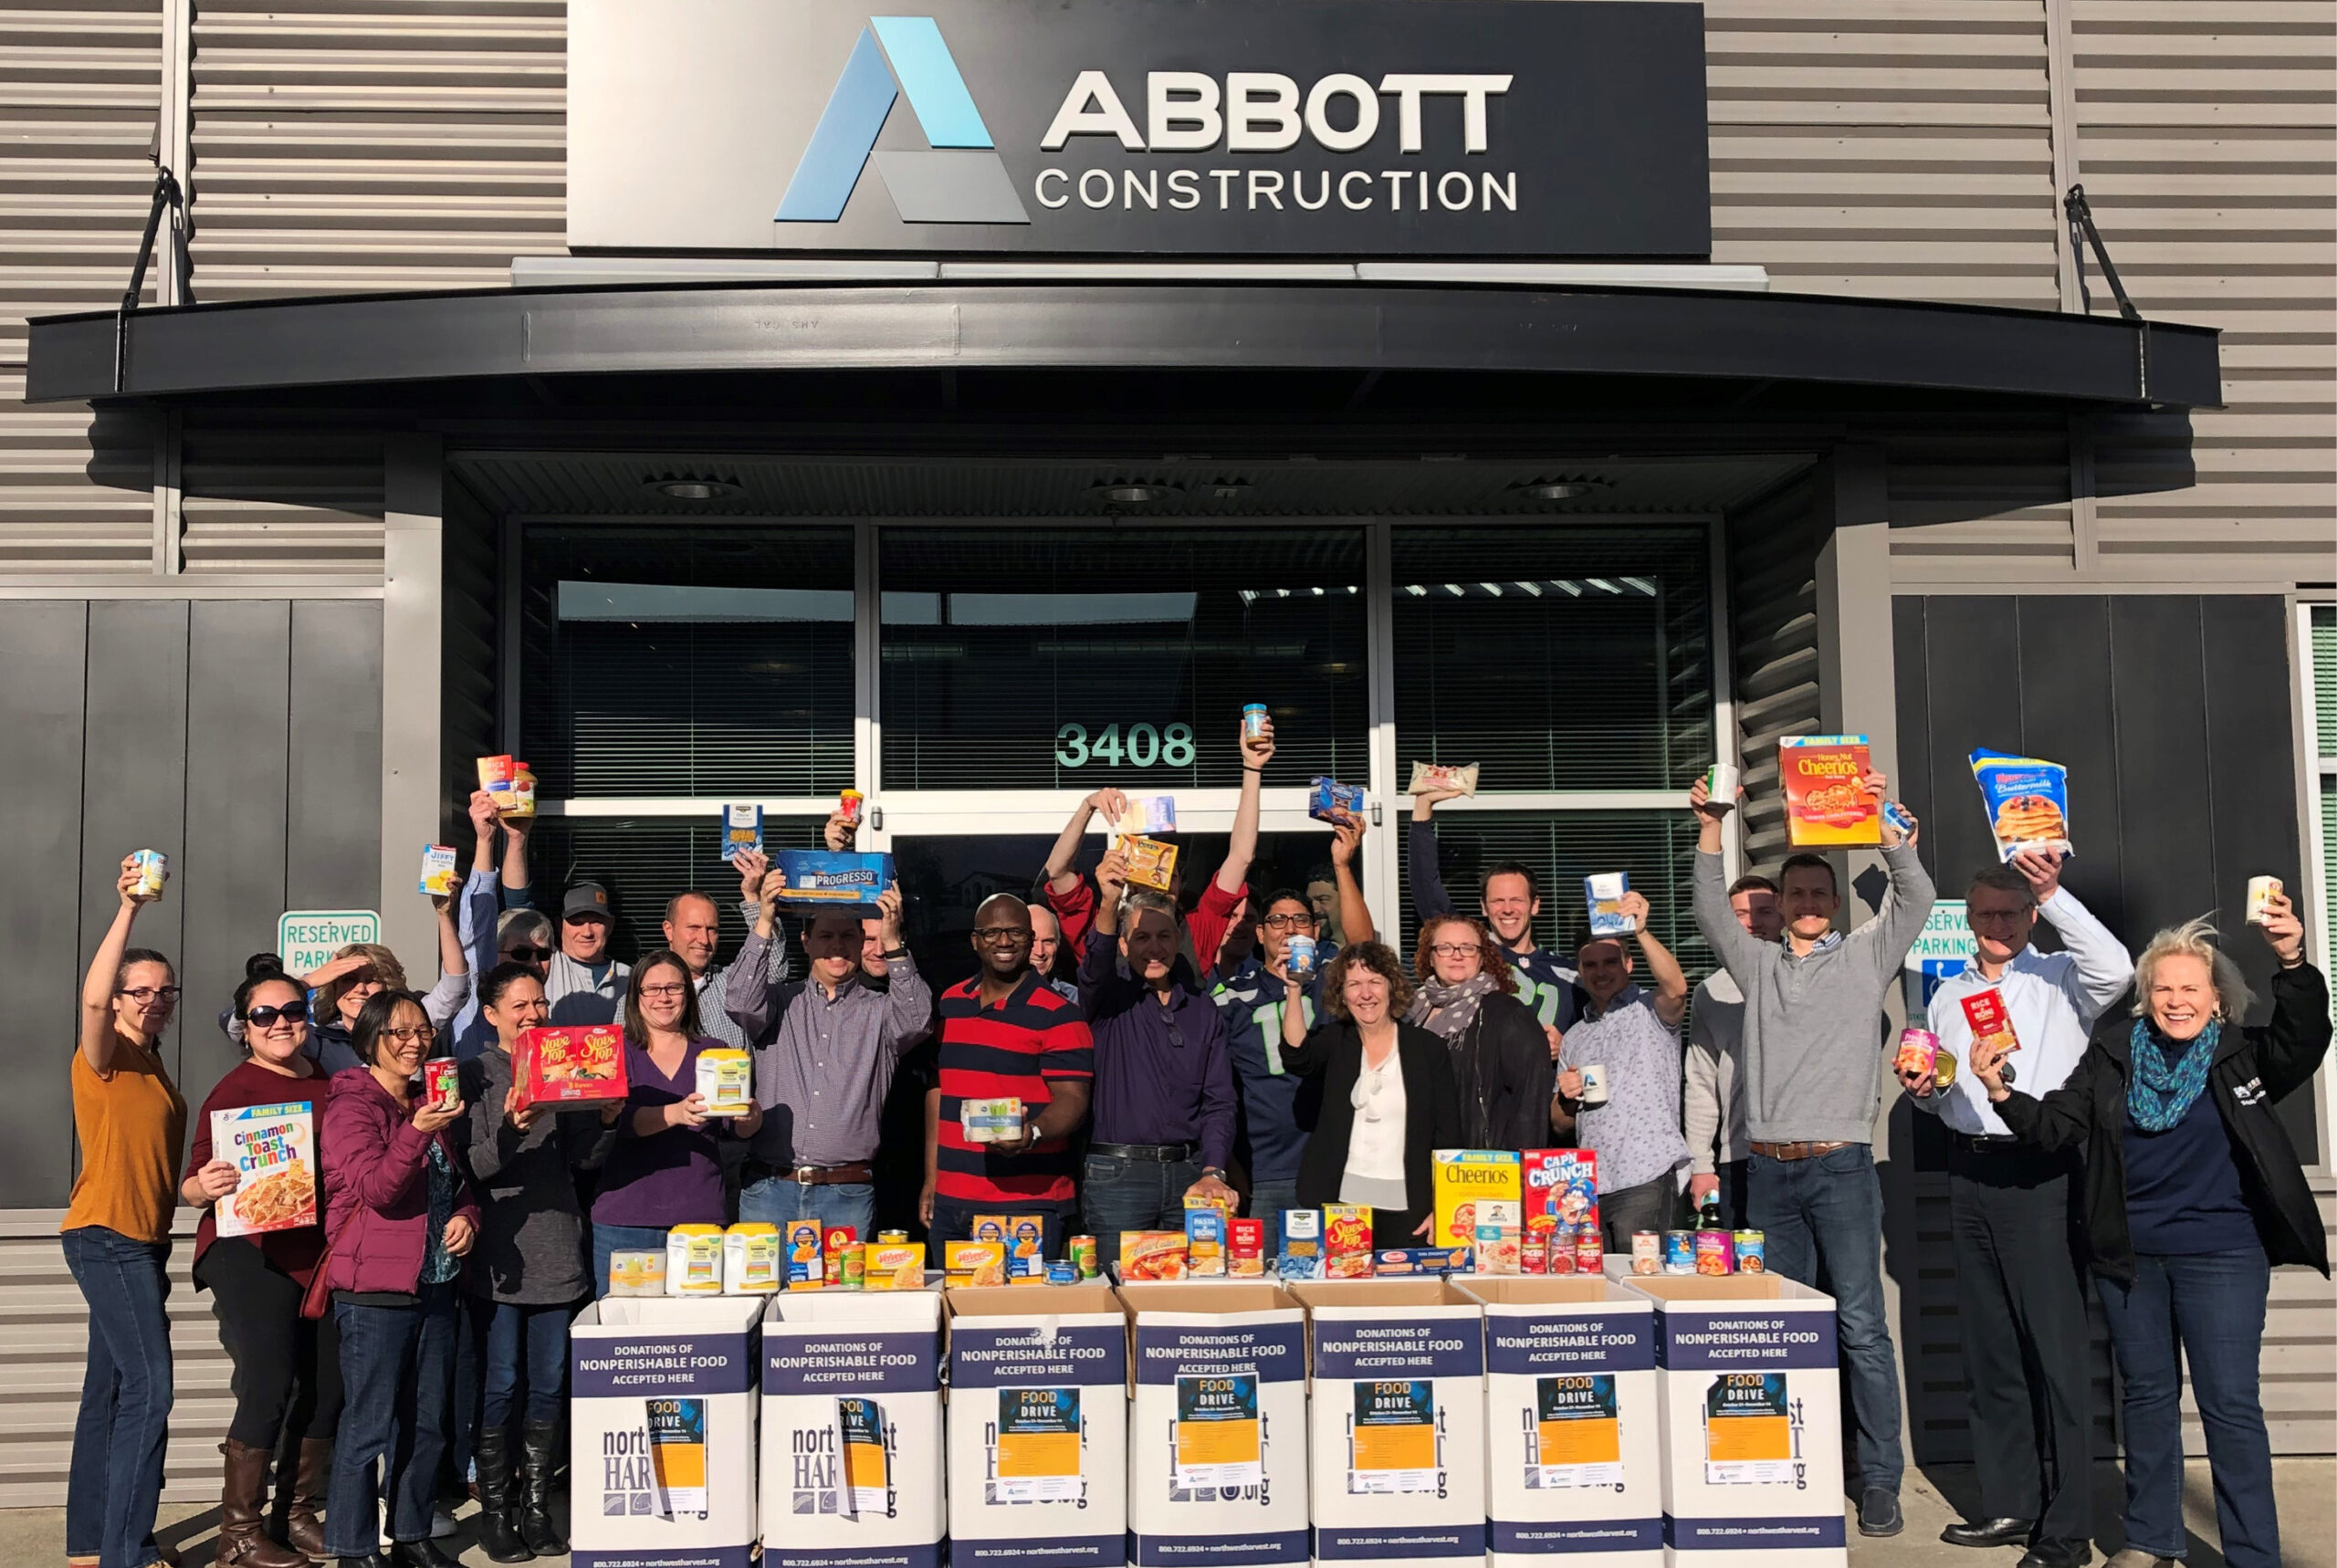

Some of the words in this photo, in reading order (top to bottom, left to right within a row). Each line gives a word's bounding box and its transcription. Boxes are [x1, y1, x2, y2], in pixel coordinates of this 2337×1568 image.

[1040, 70, 1514, 153] ABBOTT
[1035, 168, 1516, 211] CONSTRUCTION
[1056, 723, 1196, 768] 3408
[1797, 758, 1858, 776] Cheerios
[1995, 779, 2051, 793] Buttermilk
[816, 872, 873, 886] PROGRESSO
[1925, 915, 1971, 931] SERVE
[288, 925, 372, 943] RESERVED
[1913, 938, 1976, 955] PARKING
[294, 950, 334, 968] PARK
[581, 1034, 616, 1058] Stove
[548, 1049, 566, 1064] Top
[594, 1047, 613, 1061] Top
[251, 1105, 282, 1117] FAMILY
[285, 1104, 302, 1113] SIZE
[235, 1123, 294, 1145] Cinnamon
[246, 1135, 286, 1156] Toast
[239, 1144, 297, 1172] Crunch
[1544, 1152, 1577, 1169] CAP'N
[1446, 1165, 1508, 1184] Cheerios
[1529, 1162, 1594, 1187] CRUNCH
[1329, 1220, 1366, 1244] Stove
[1343, 1236, 1361, 1248] Top
[878, 1250, 913, 1263] Velveeta
[958, 1250, 992, 1262] Velveeta
[1529, 1323, 1588, 1333] DONATIONS
[1590, 1322, 1604, 1332] OF
[1709, 1321, 1768, 1331] DONATIONS
[1771, 1321, 1785, 1330] OF
[1356, 1328, 1415, 1338] DONATIONS
[1417, 1328, 1431, 1337] OF
[1675, 1333, 1779, 1345] NONPERISHABLE
[1783, 1333, 1818, 1343] FOOD
[1059, 1336, 1072, 1344] OF
[1179, 1335, 1239, 1345] DONATIONS
[1242, 1334, 1254, 1343] OF
[1496, 1335, 1598, 1348] NONPERISHABLE
[1601, 1334, 1636, 1346] FOOD
[614, 1345, 676, 1355] DONATIONS
[679, 1344, 693, 1354] OF
[805, 1343, 866, 1354] DONATIONS
[869, 1343, 883, 1352] OF
[1146, 1346, 1249, 1358] NONPERISHABLE
[1252, 1344, 1285, 1356] FOOD
[1323, 1341, 1425, 1353] NONPERISHABLE
[1429, 1340, 1463, 1351] FOOD
[961, 1349, 1066, 1361] NONPERISHABLE
[1070, 1348, 1106, 1359] FOOD
[1528, 1353, 1579, 1362] ACCEPTED
[1581, 1351, 1607, 1361] HERE
[1708, 1349, 1759, 1358] ACCEPTED
[1762, 1348, 1787, 1357] HERE
[580, 1357, 686, 1371] NONPERISHABLE
[691, 1356, 728, 1367] FOOD
[770, 1354, 876, 1368] NONPERISHABLE
[880, 1354, 917, 1365] FOOD
[1355, 1357, 1405, 1366] ACCEPTED
[1408, 1356, 1433, 1365] HERE
[994, 1365, 1045, 1375] ACCEPTED
[1048, 1364, 1074, 1374] HERE
[1178, 1364, 1230, 1374] ACCEPTED
[1231, 1363, 1256, 1372] HERE
[613, 1375, 665, 1385] ACCEPTED
[668, 1374, 695, 1383] HERE
[803, 1372, 855, 1382] ACCEPTED
[858, 1372, 885, 1381] HERE
[1727, 1375, 1765, 1387] FOOD
[1200, 1380, 1235, 1392] FOOD
[1375, 1383, 1411, 1395] FOOD
[1557, 1377, 1595, 1390] FOOD
[1021, 1392, 1057, 1403] FOOD
[1200, 1394, 1235, 1406] DRIVE
[1558, 1392, 1595, 1404] DRIVE
[1728, 1388, 1765, 1401] DRIVE
[840, 1400, 865, 1413] OOD
[1375, 1397, 1411, 1409] DRIVE
[1021, 1406, 1057, 1417] DRIVE
[1567, 1530, 1638, 1538] northwestharvest.org
[1747, 1527, 1820, 1535] northwestharvest.org
[1388, 1536, 1459, 1544] northwestharvest.org
[1026, 1546, 1099, 1555] northwestharvest.org
[1210, 1542, 1282, 1552] northwestharvest.org
[593, 1560, 639, 1568] 800.722.6924
[645, 1558, 720, 1568] northwestharvest.org
[782, 1559, 828, 1567] 800.722.6924
[833, 1556, 908, 1566] northwestharvest.org
